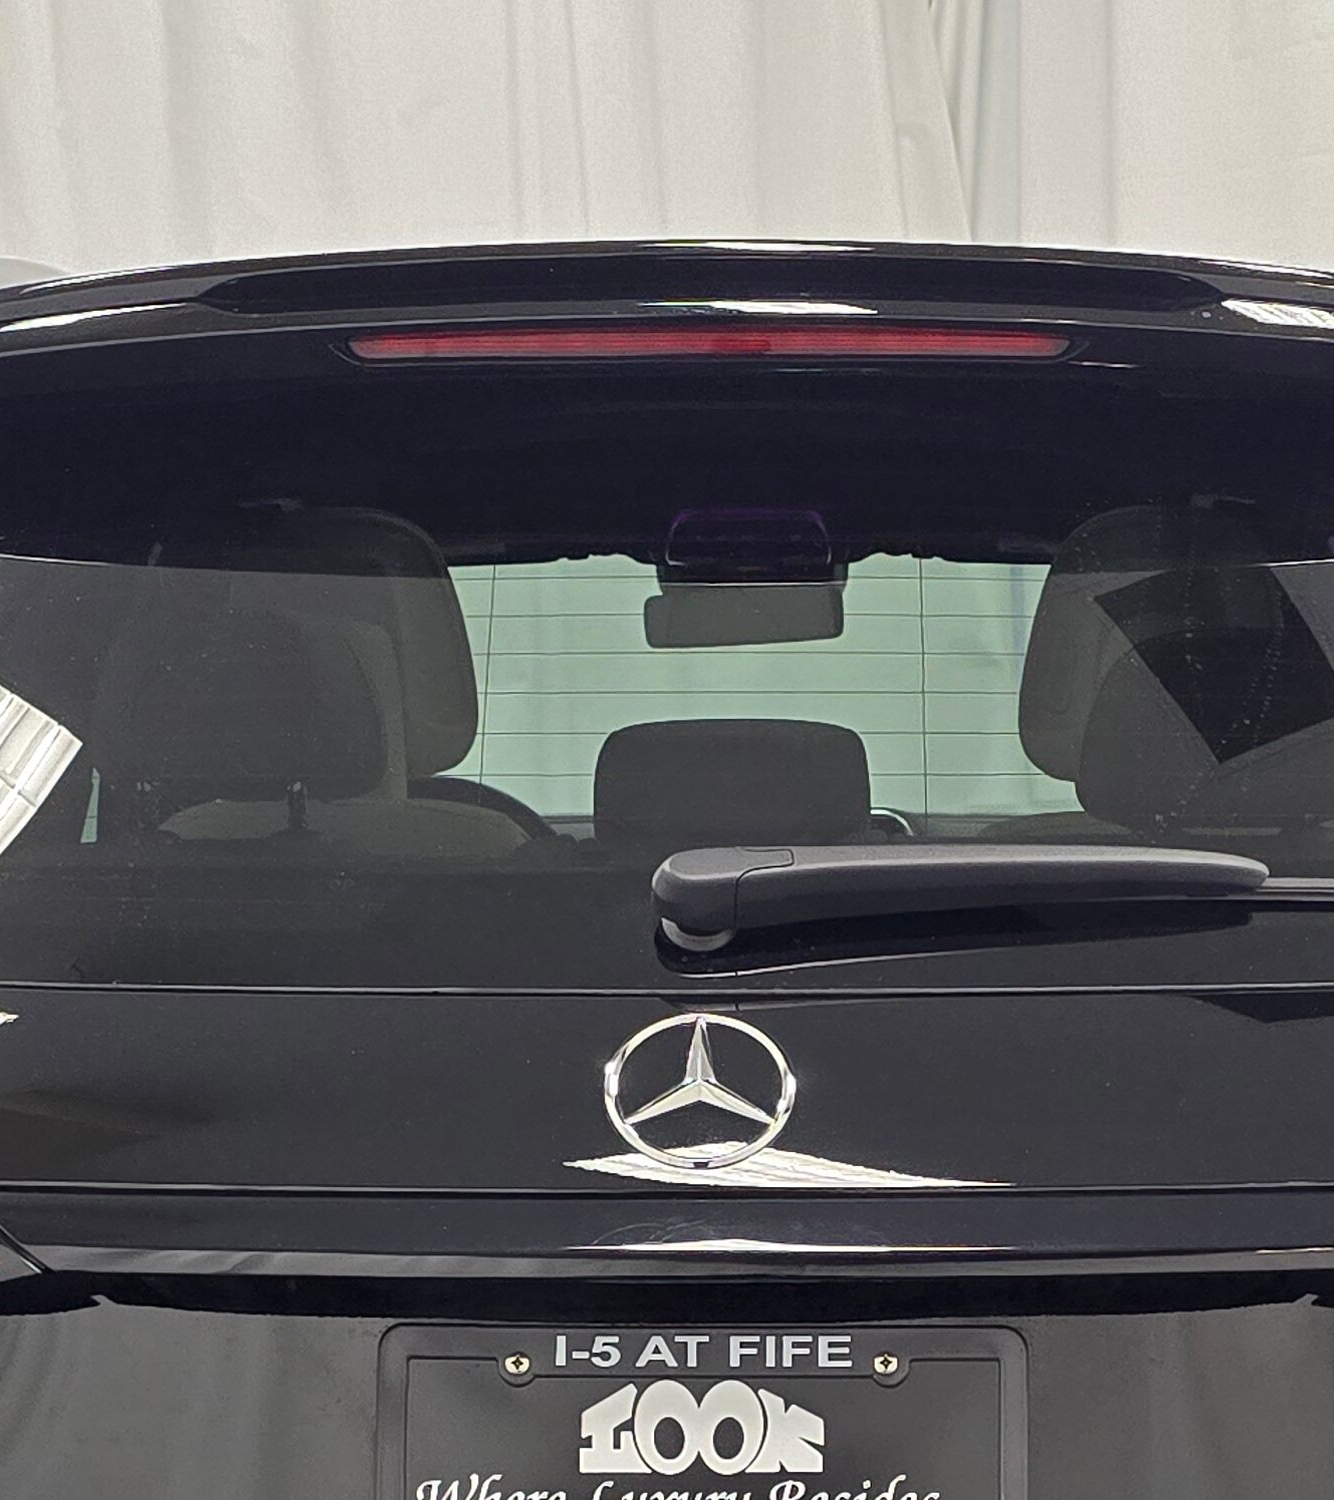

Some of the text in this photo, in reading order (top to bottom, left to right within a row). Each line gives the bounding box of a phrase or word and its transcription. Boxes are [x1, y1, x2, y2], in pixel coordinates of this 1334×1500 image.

[555, 1335, 853, 1368] I-5 AT FIFE
